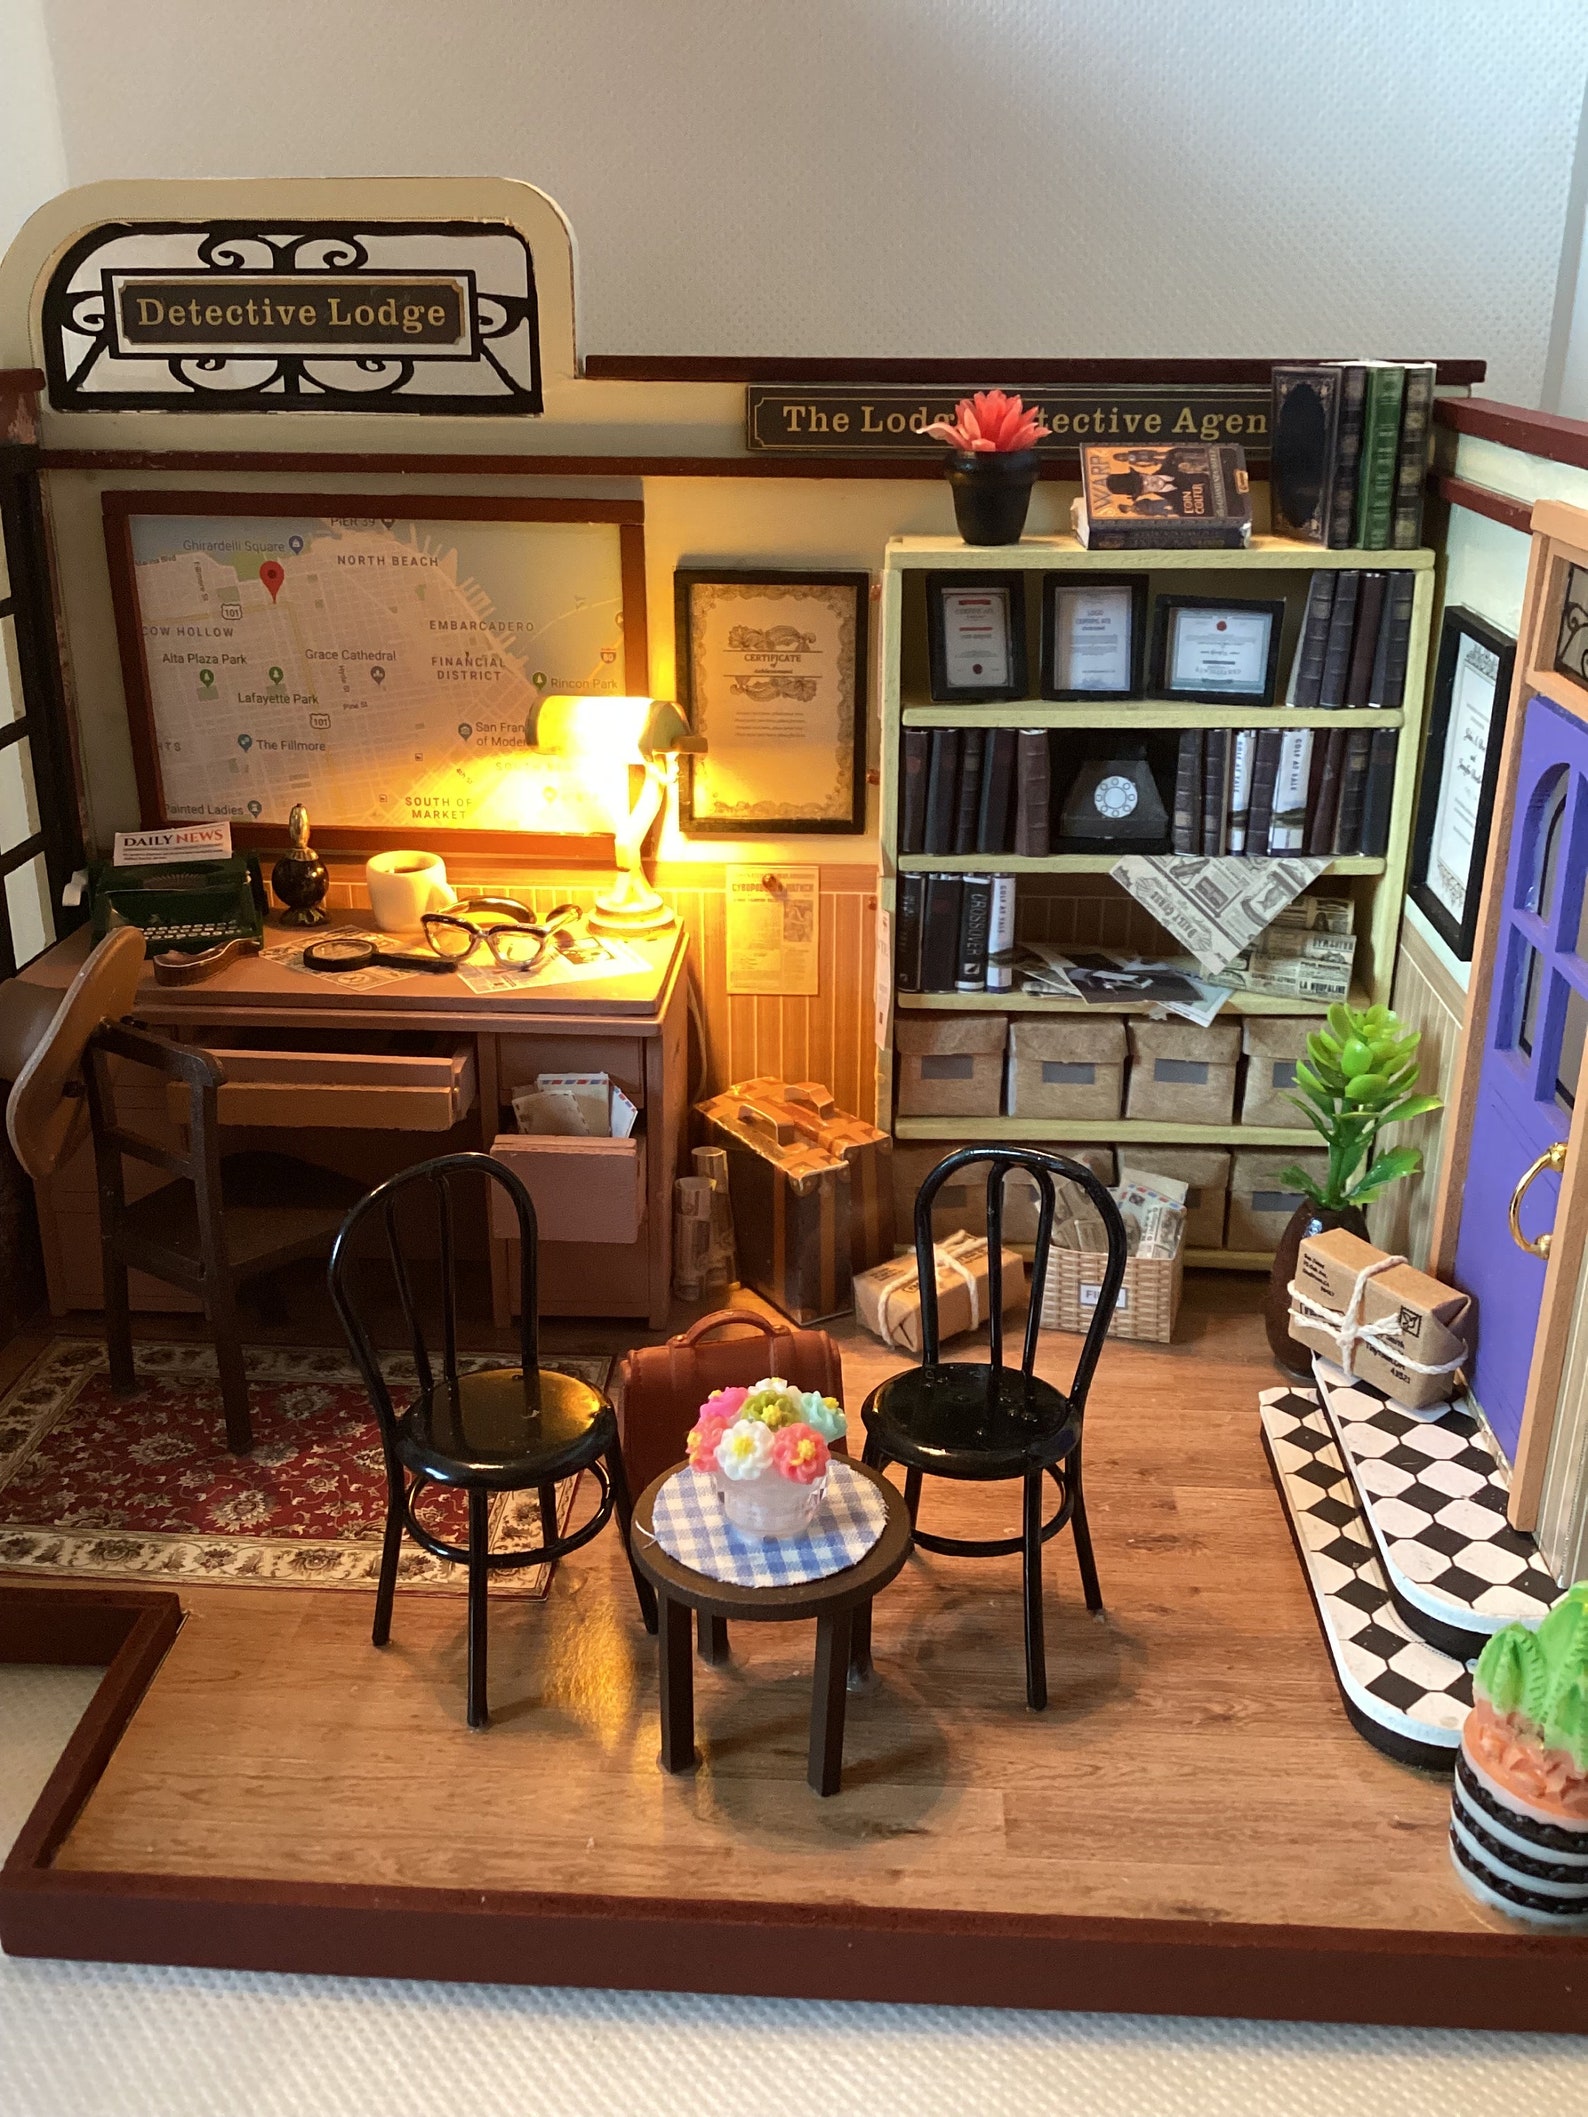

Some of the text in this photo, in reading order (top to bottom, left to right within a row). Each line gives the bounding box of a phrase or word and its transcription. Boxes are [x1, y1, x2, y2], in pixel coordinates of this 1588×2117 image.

[137, 298, 446, 333] Detective Lodge
[783, 405, 849, 433] The
[1036, 406, 1162, 434] tective
[1171, 406, 1268, 441] Agen
[183, 540, 285, 554] Ghirardelli Square
[337, 555, 439, 567] NORTH BEACH
[224, 608, 239, 618] 101
[142, 626, 234, 637] COW HOLLOW
[429, 620, 535, 632] EMBARCADERO
[162, 652, 248, 665] Alta Plaza Park
[305, 649, 396, 662] Grace Cathedral
[744, 653, 802, 663] CERTIFICATE
[431, 656, 506, 668] FINANCIAL
[436, 669, 502, 681] DISTRICT
[550, 678, 619, 690] Rincon Park
[238, 692, 319, 705] Lafayette Park
[313, 717, 328, 727] 101
[475, 722, 526, 733] San Fran
[256, 740, 326, 752] The Fillmore
[476, 736, 528, 747] of Moder
[405, 796, 473, 808] SOUTH OF
[206, 804, 244, 816] Ladies
[411, 809, 466, 820] MARKET
[124, 829, 224, 847] DAILY NEWS
[966, 893, 987, 956] CROSSOVER
